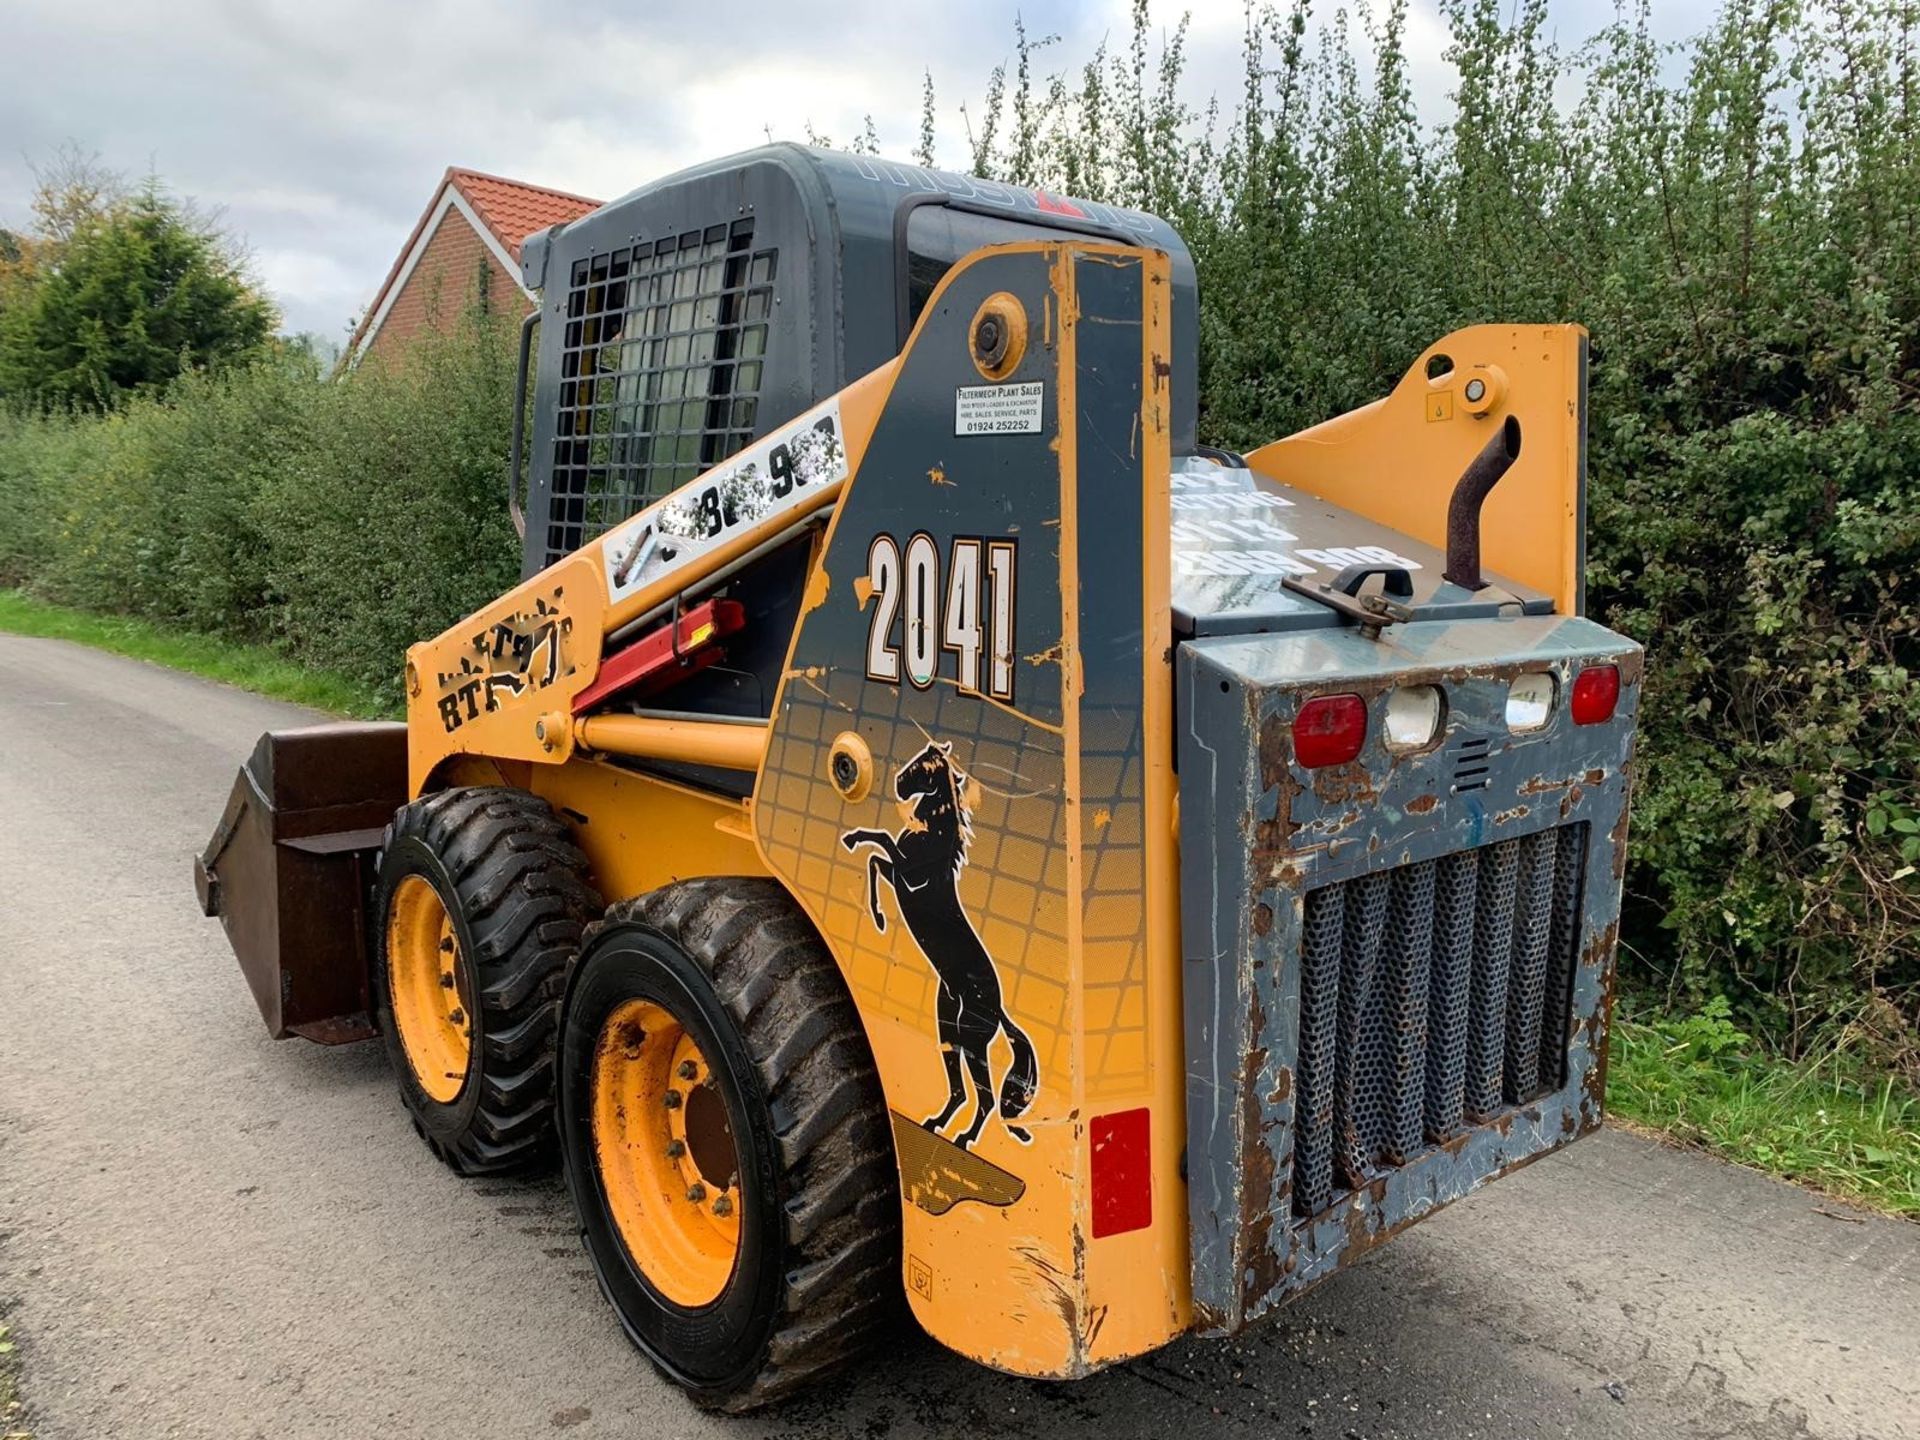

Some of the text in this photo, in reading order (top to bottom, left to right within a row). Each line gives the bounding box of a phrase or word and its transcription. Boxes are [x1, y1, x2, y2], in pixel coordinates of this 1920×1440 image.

[967, 420, 1030, 432] 01924 252252
[866, 530, 1018, 704] 2041
